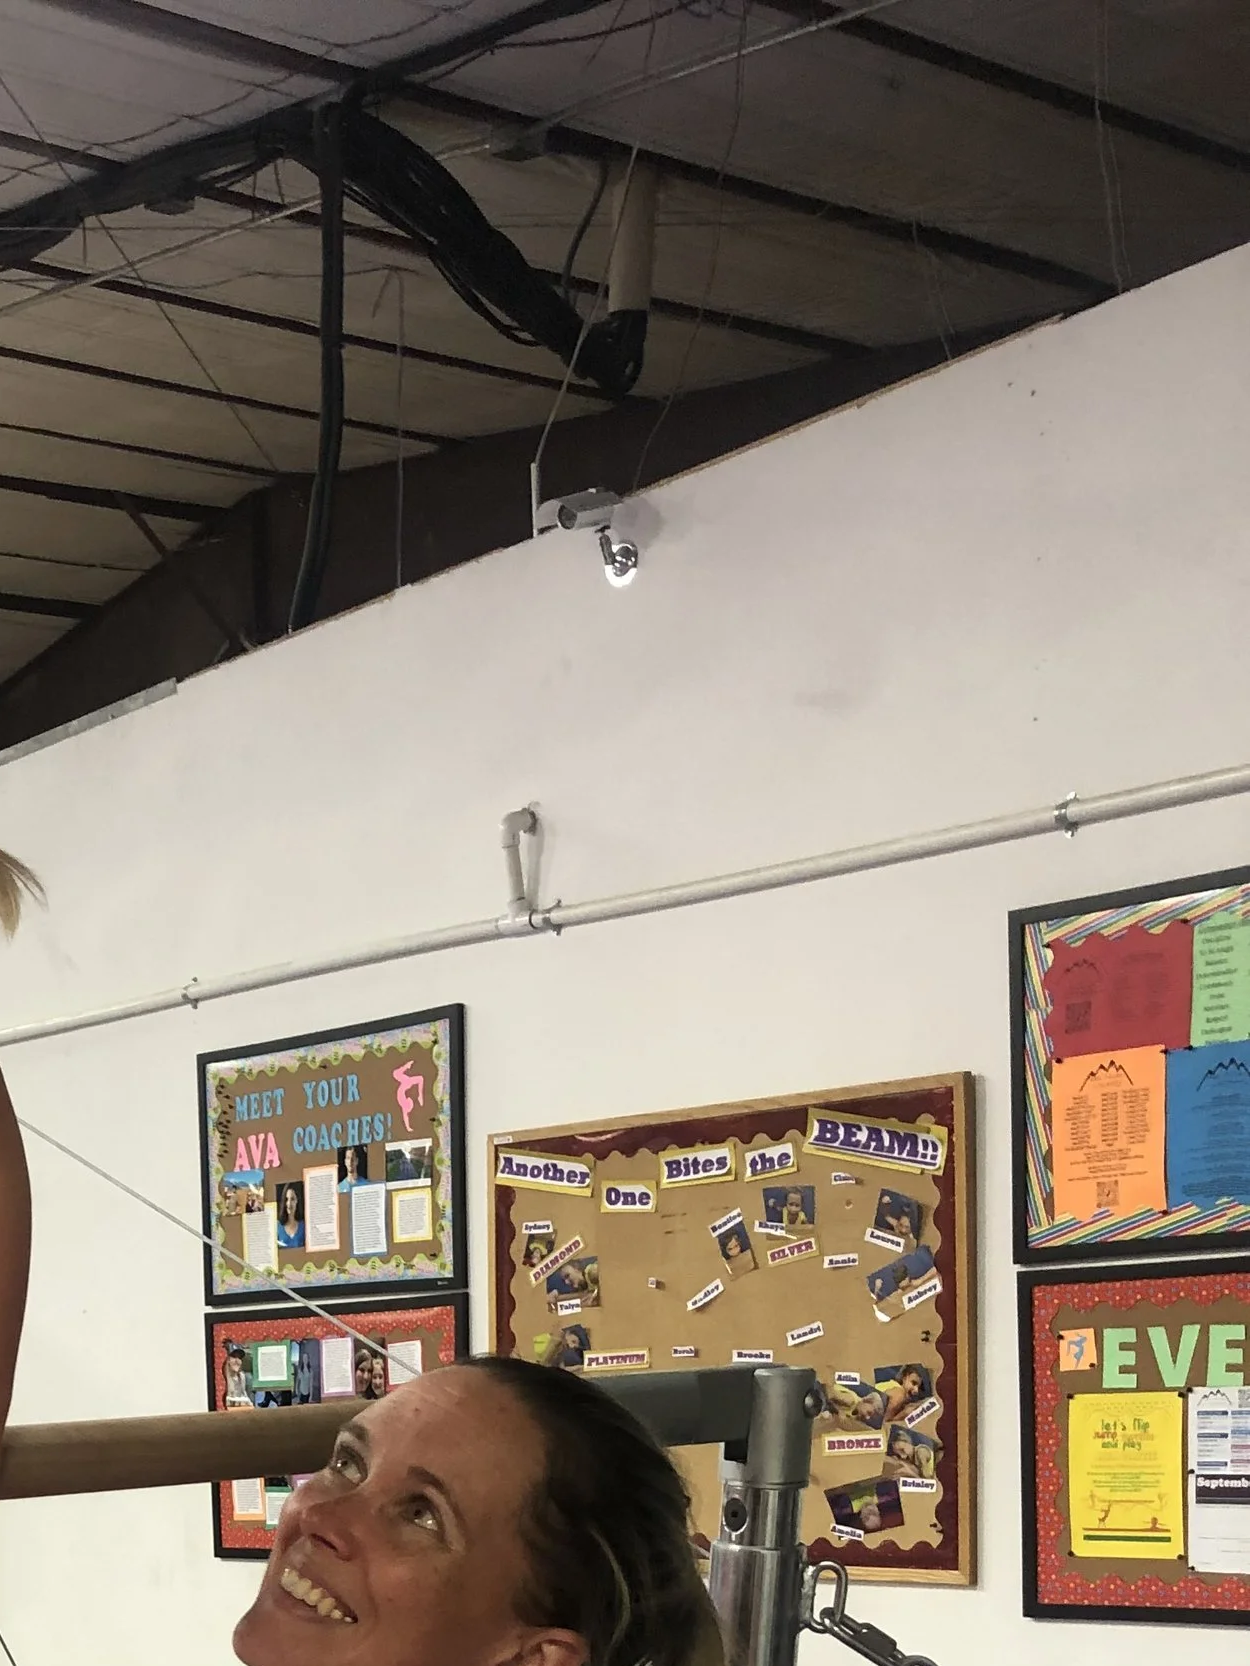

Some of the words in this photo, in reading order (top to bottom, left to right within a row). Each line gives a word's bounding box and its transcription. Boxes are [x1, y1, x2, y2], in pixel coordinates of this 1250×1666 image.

[235, 1088, 285, 1121] MEET
[303, 1073, 361, 1110] YOUR
[234, 1132, 281, 1172] AVA
[293, 1112, 392, 1154] COACHES!
[500, 1156, 590, 1185] Another
[605, 1187, 651, 1206] One
[664, 1154, 728, 1180] Bites
[749, 1150, 791, 1175] the
[814, 1118, 940, 1161] BEAM!!
[532, 1238, 581, 1282] DIAMOND
[769, 1240, 814, 1263] SILVER
[587, 1353, 646, 1366] PLATINUM
[827, 1438, 882, 1451] BRONZE
